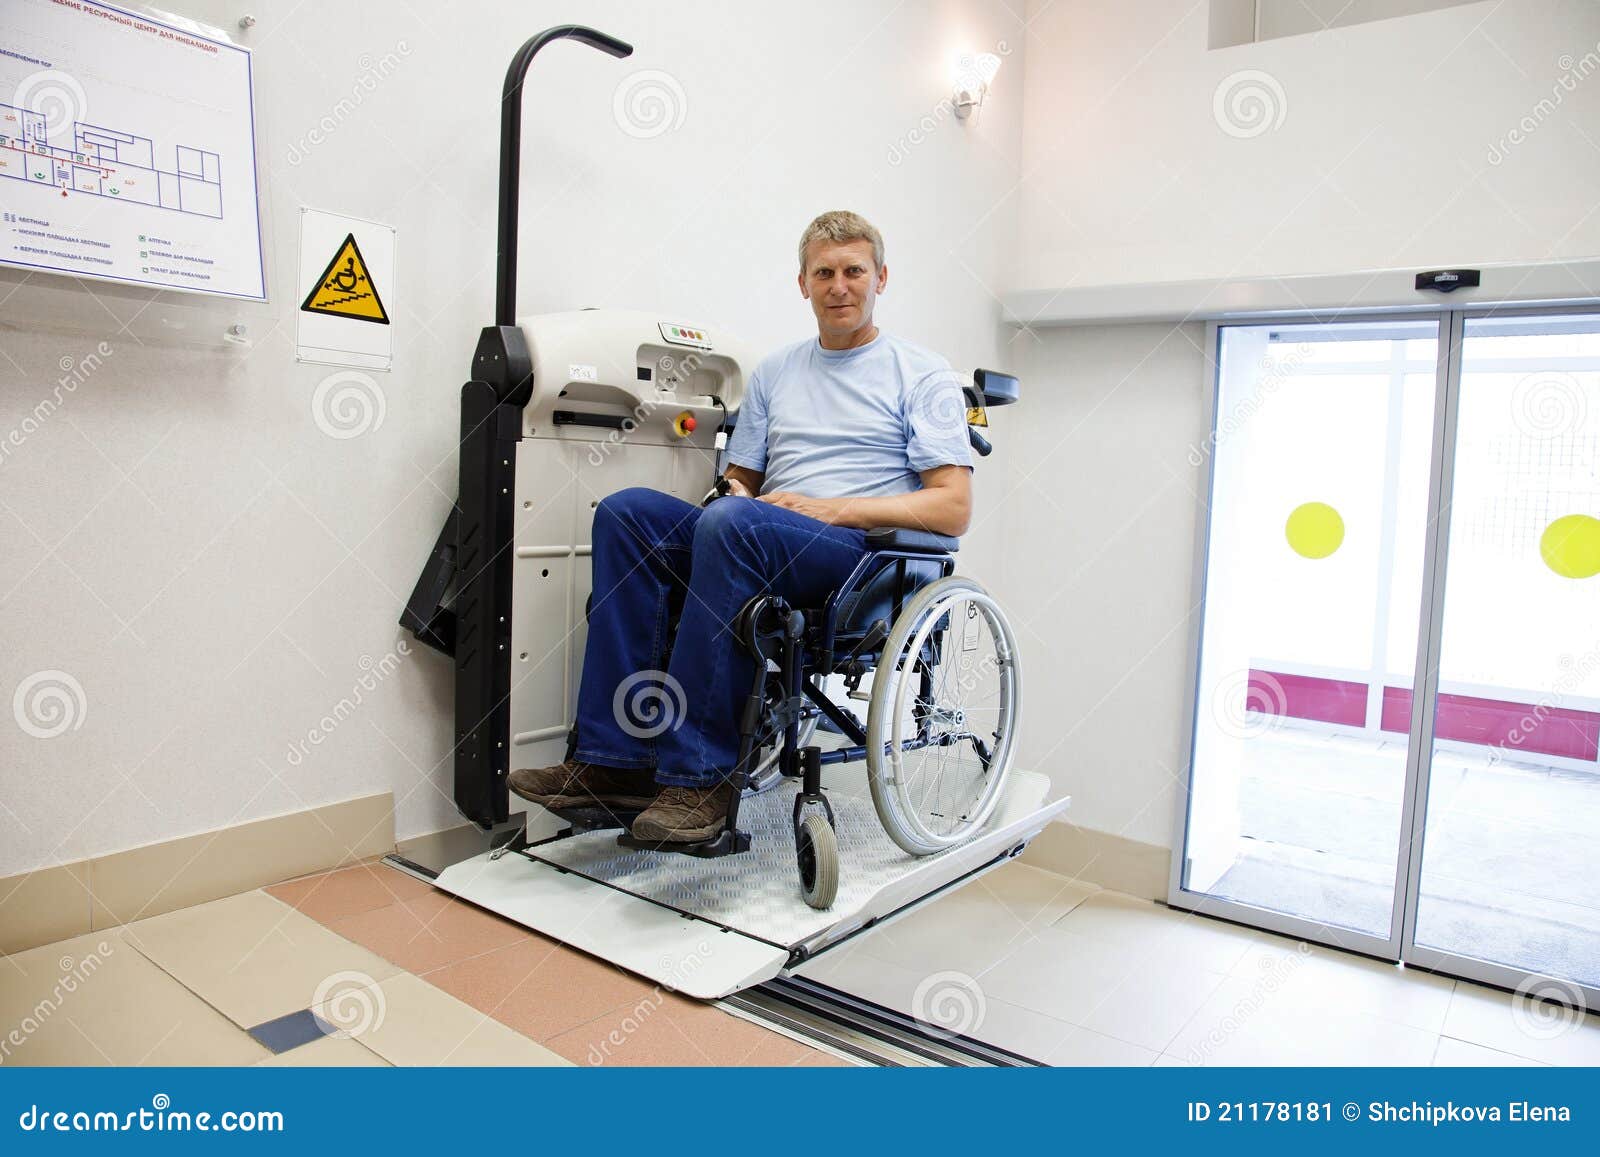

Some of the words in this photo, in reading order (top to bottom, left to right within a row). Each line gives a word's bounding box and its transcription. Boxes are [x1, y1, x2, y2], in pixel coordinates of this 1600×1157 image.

[83, 5, 132, 27] РЕСУРСНЫЙ
[134, 22, 158, 33] ЦЕНТР
[159, 29, 174, 40] ДЛЯ
